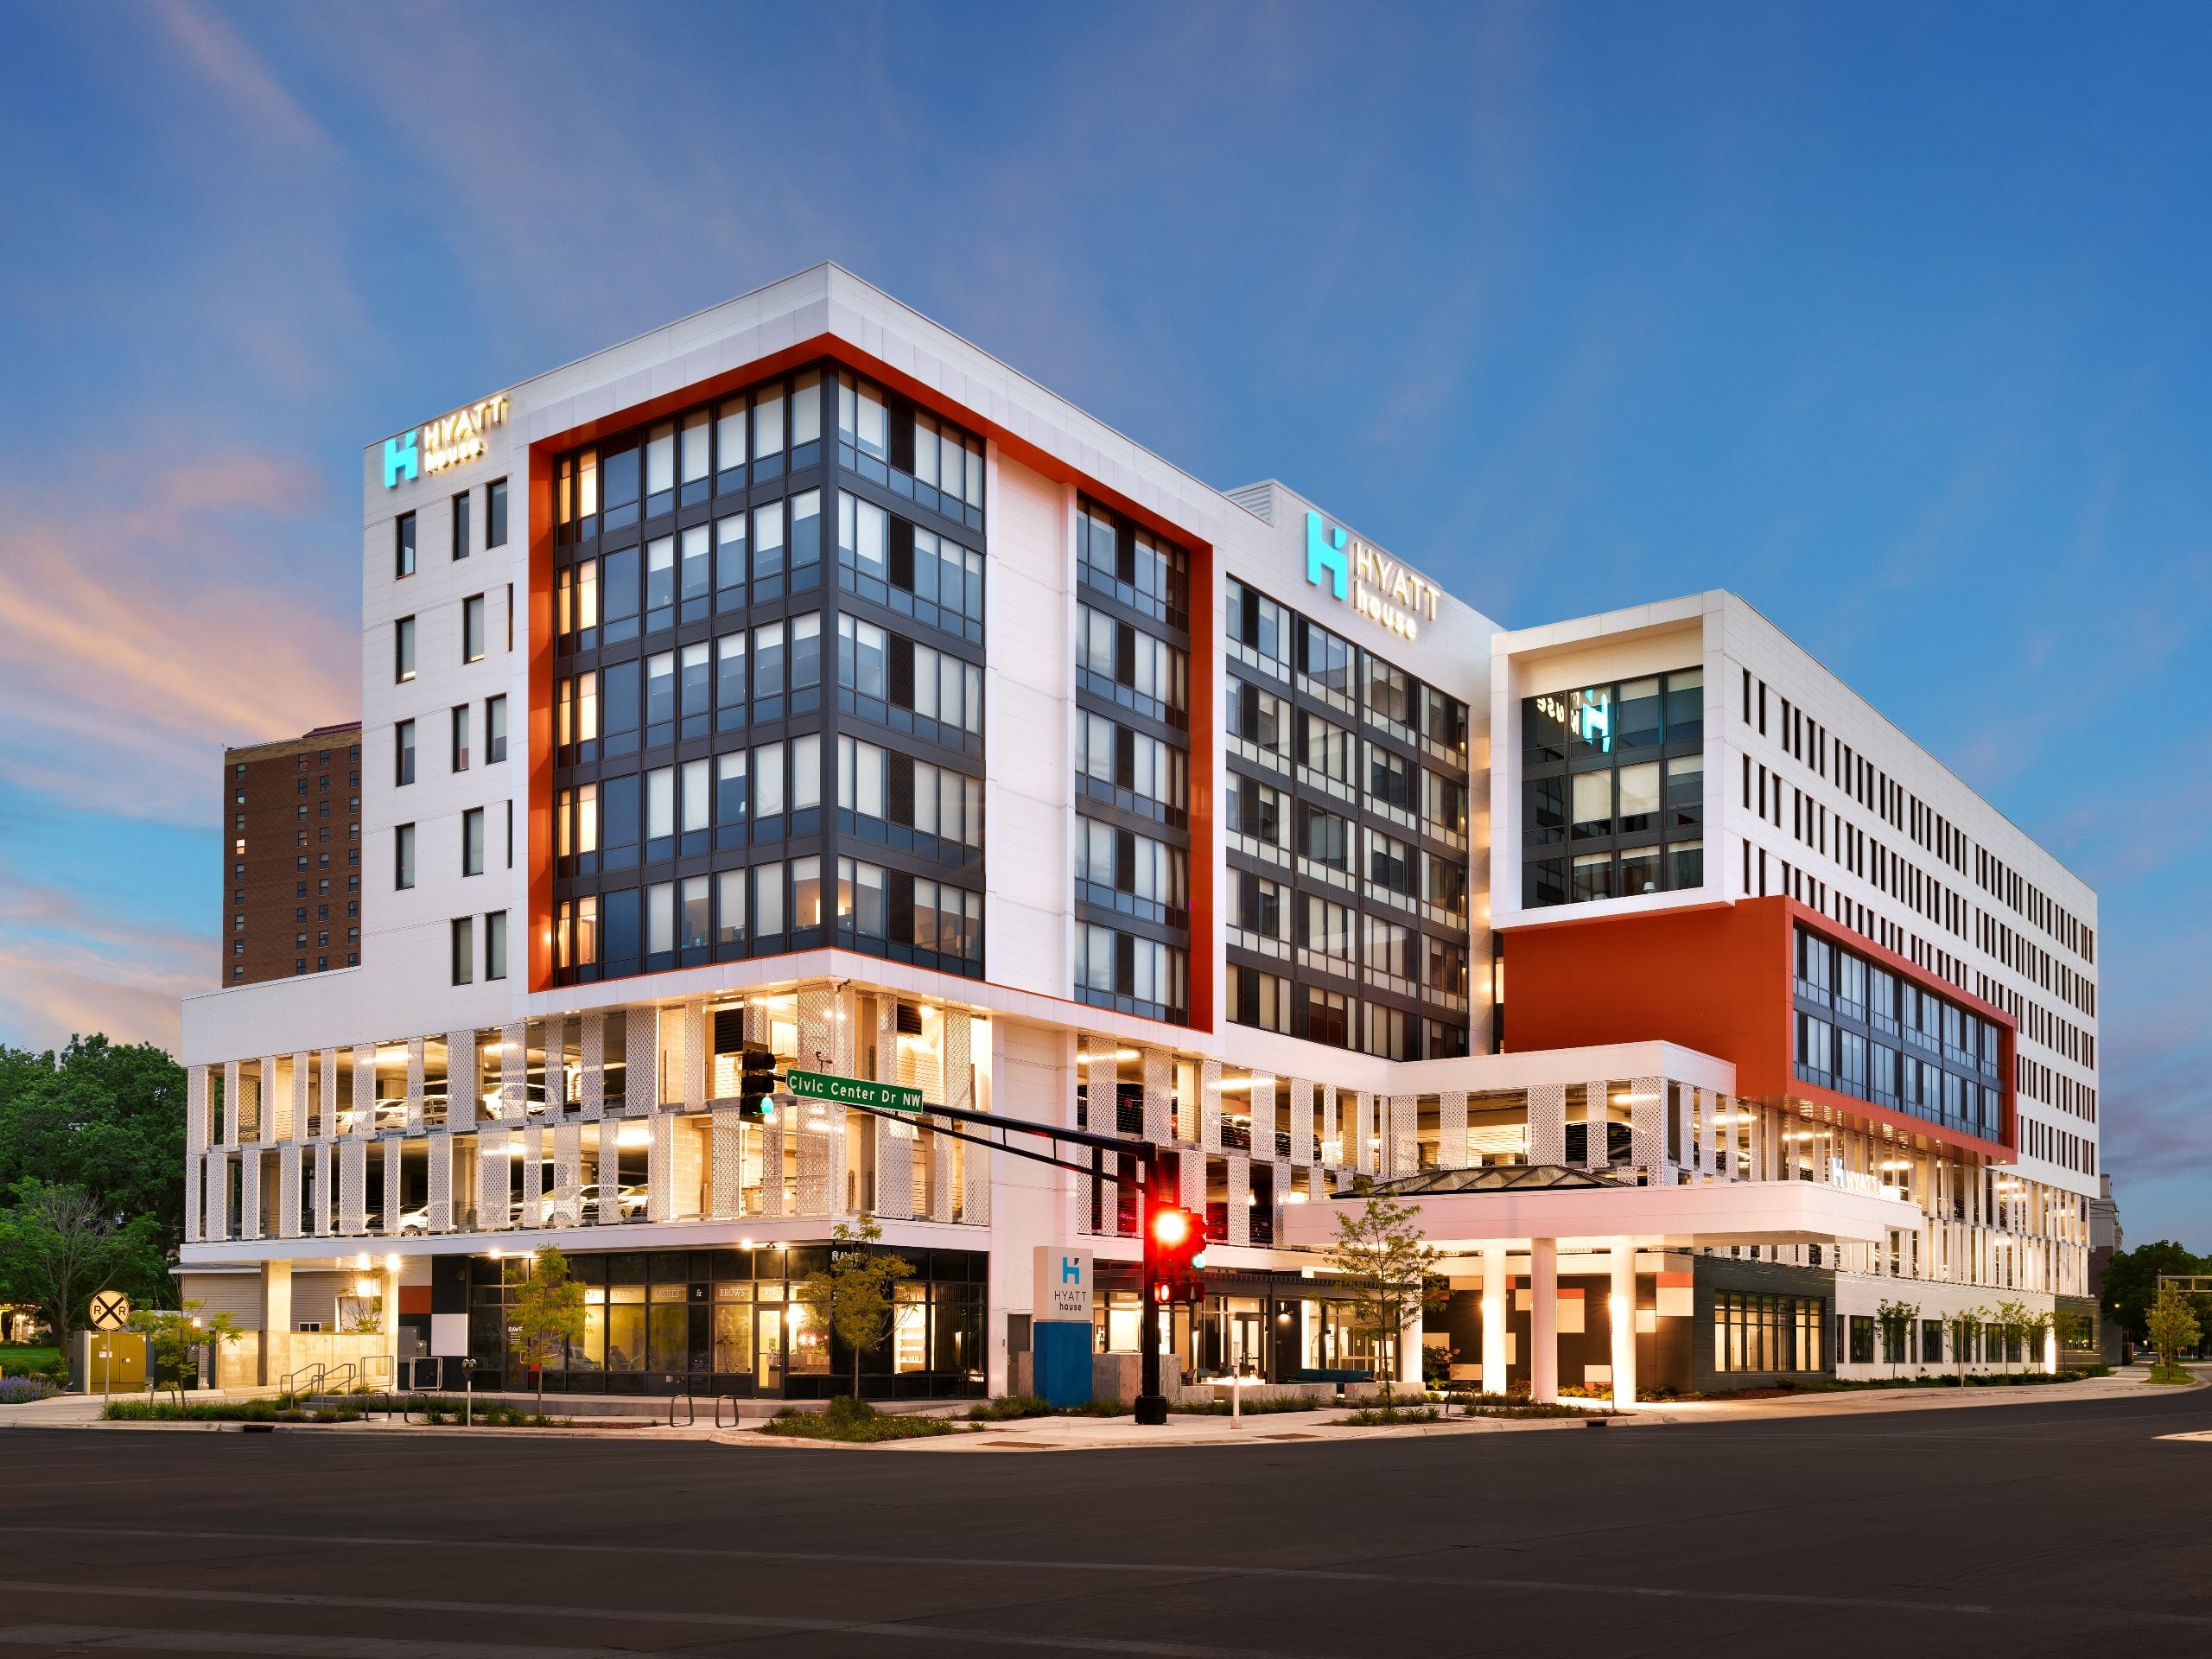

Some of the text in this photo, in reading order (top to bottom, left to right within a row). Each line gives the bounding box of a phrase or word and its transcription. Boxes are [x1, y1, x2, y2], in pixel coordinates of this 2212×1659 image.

[425, 396, 506, 450] HYATT
[1354, 541, 1440, 620] HYATT
[1354, 580, 1417, 639] house
[789, 1075, 921, 1108] Civic Center Dr NW
[720, 1288, 746, 1297] BROWS
[1054, 1290, 1087, 1302] HYATT
[1059, 1301, 1082, 1311] house
